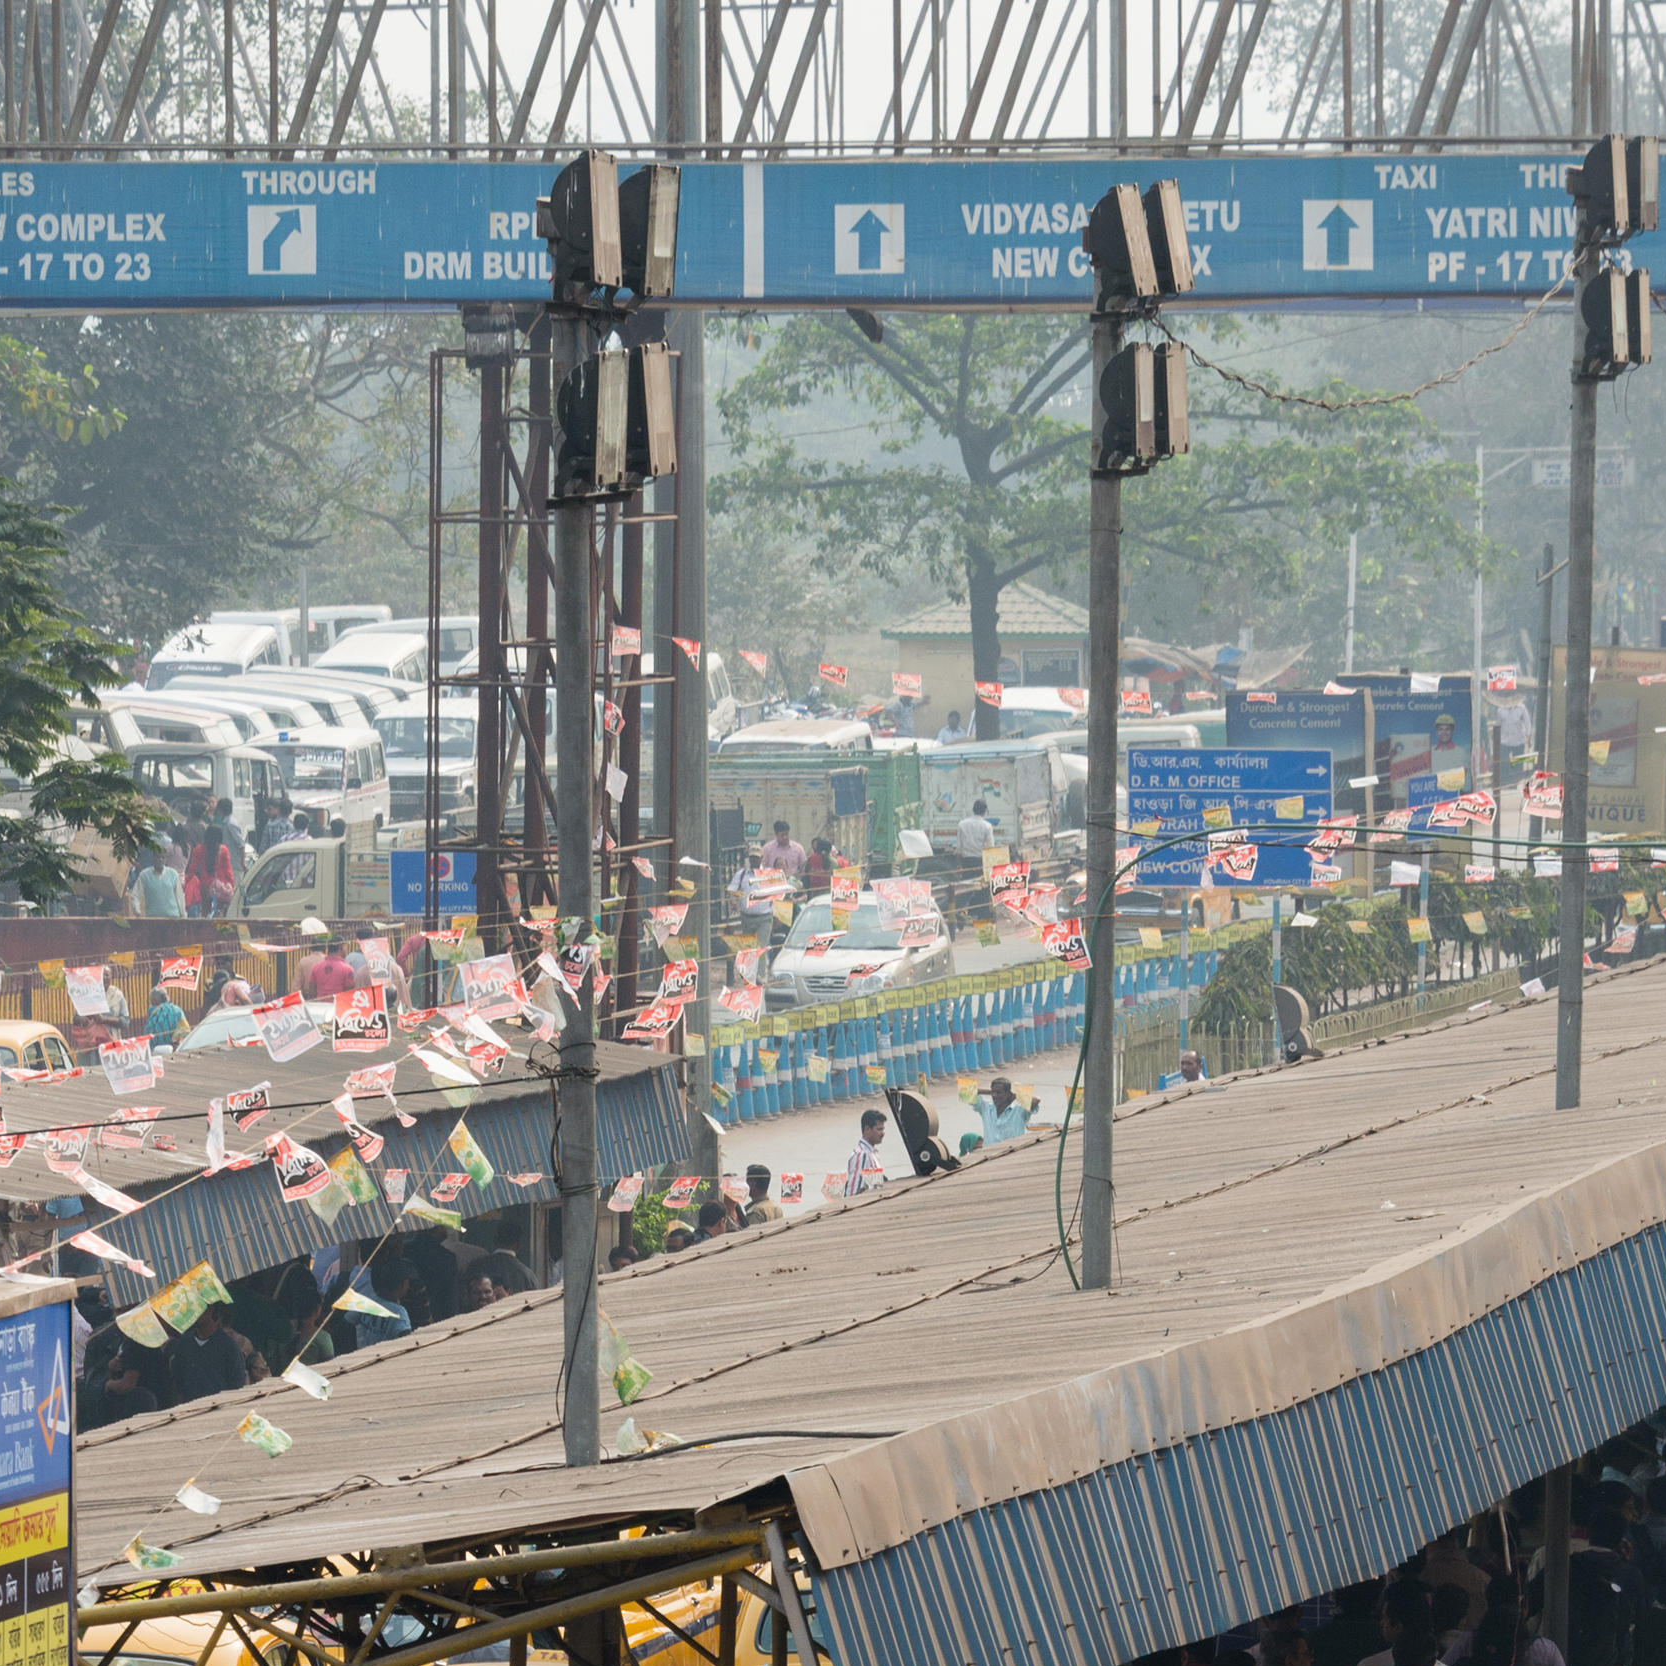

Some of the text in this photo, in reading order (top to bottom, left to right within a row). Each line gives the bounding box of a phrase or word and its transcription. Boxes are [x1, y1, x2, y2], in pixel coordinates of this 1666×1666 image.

[242, 170, 376, 195] THROUGH
[1374, 165, 1437, 189] TAXI
[16, 213, 166, 243] COMPLEX
[1426, 208, 1516, 240] YATRI
[18, 253, 50, 282] 17
[62, 253, 104, 281] TO
[114, 253, 151, 281] 23
[404, 252, 471, 281] DRM
[992, 246, 1060, 279] NEW
[1428, 249, 1532, 281] PF 17
[1187, 775, 1241, 788] OFFICE
